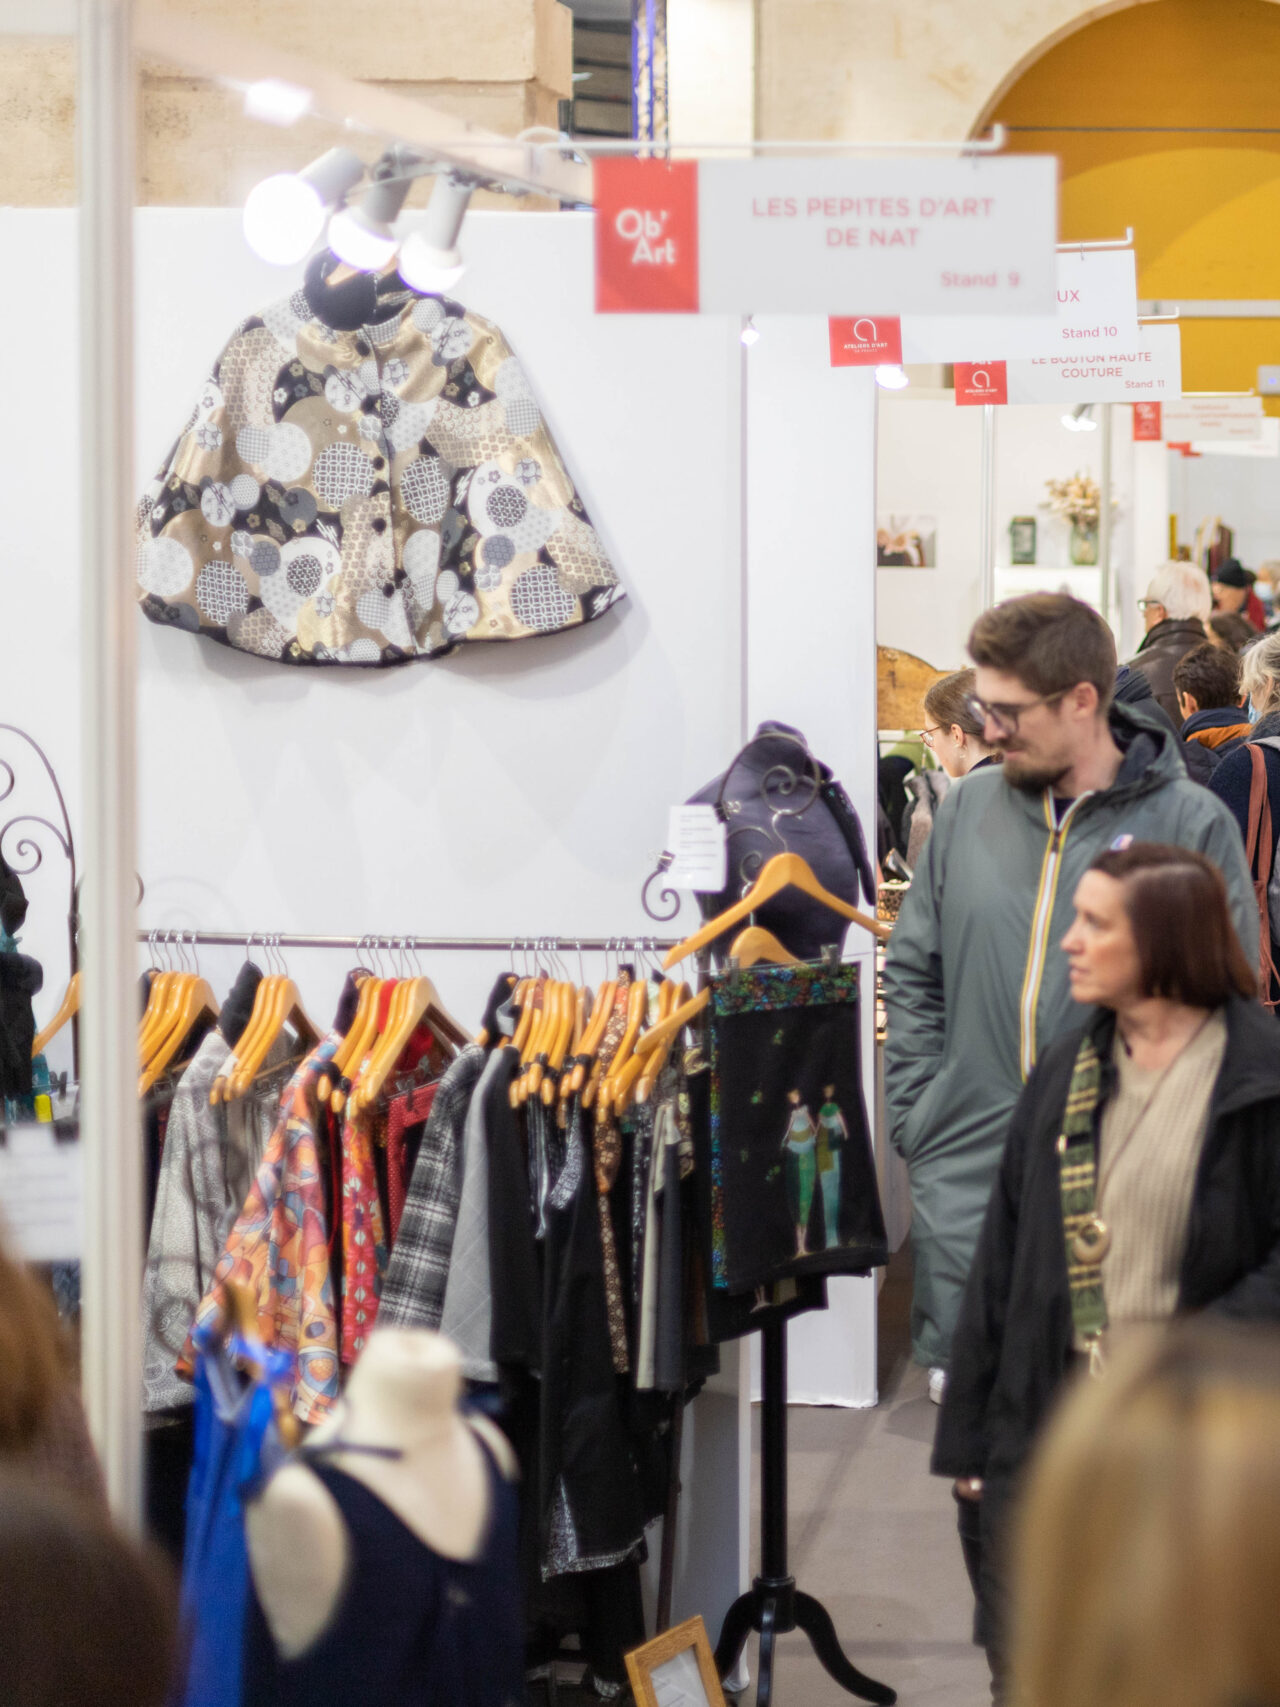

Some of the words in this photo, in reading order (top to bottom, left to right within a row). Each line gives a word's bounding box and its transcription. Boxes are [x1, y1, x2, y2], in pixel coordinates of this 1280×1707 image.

[751, 197, 798, 217] LES
[806, 197, 910, 217] PEPITES
[919, 197, 995, 217] D'ART
[615, 208, 669, 240] Ob'
[825, 227, 859, 247] DE
[868, 227, 920, 247] NAT
[631, 236, 675, 264] Art
[940, 271, 998, 287] Stand
[1007, 271, 1020, 287] 9
[1061, 327, 1100, 339] Stand
[1104, 326, 1118, 337] 10
[1109, 352, 1152, 362] HAUTE
[1061, 367, 1123, 378] COUTURE
[1124, 380, 1153, 389] Stand
[1157, 380, 1165, 388] 11
